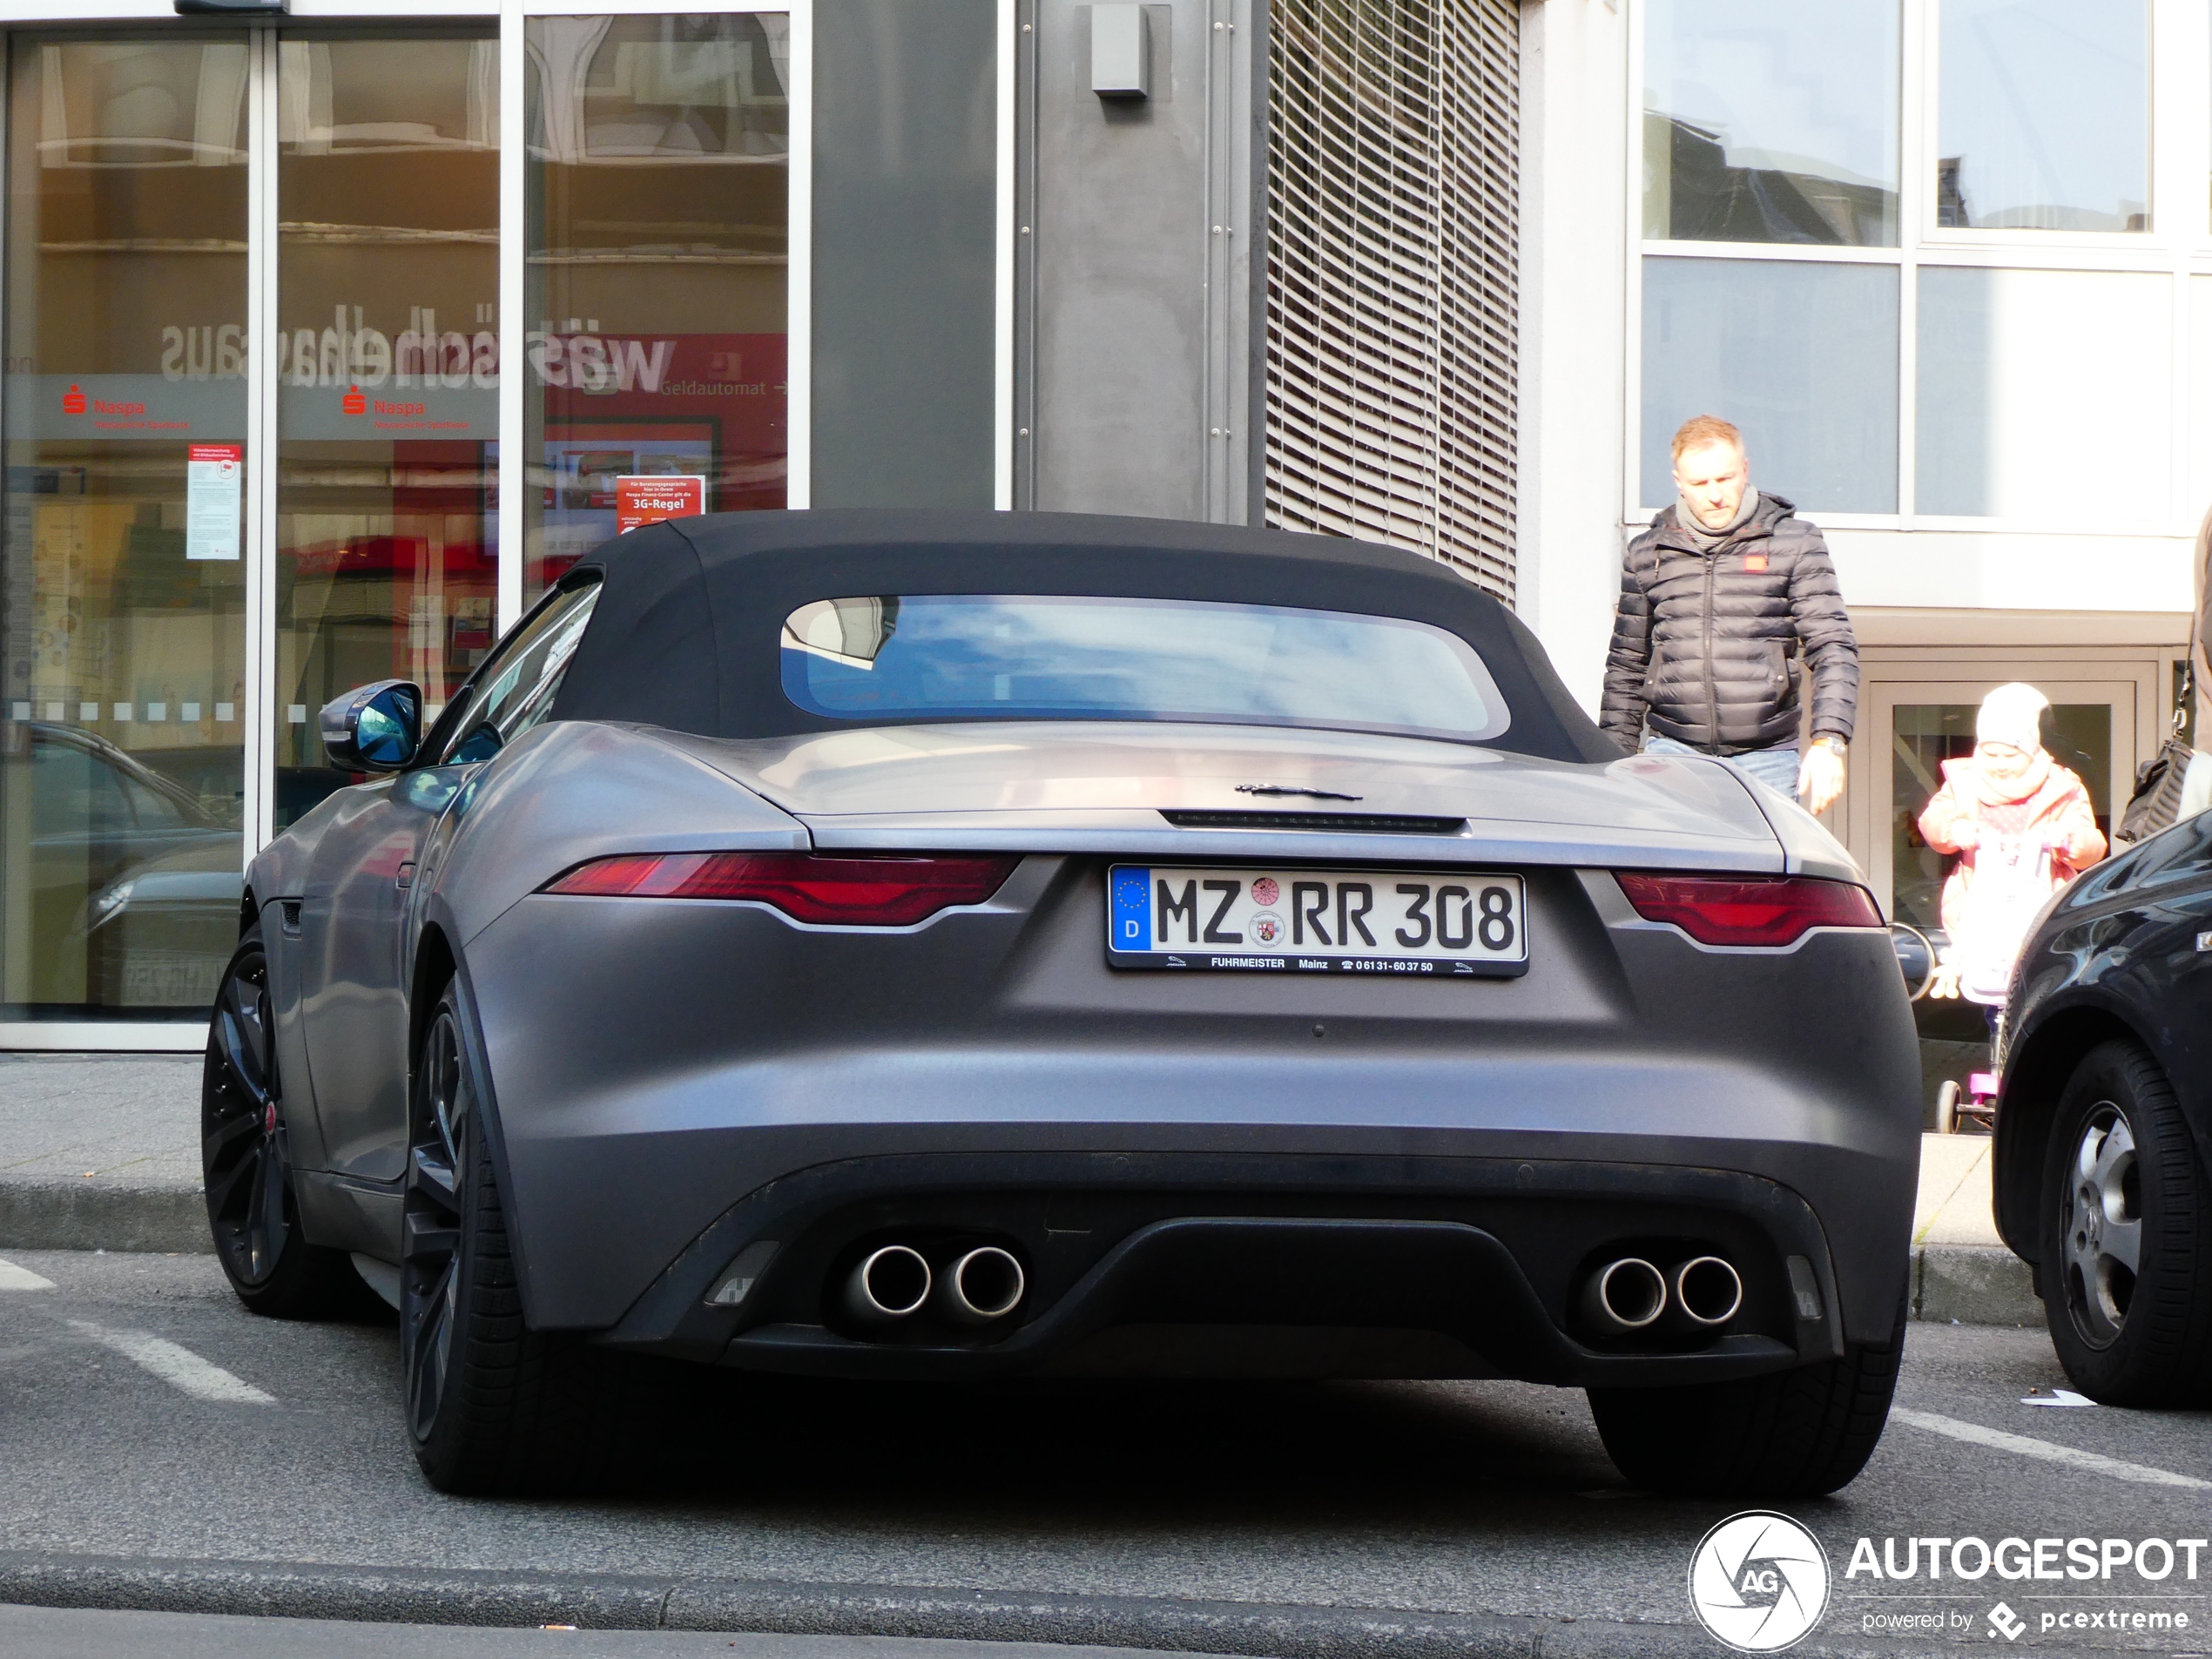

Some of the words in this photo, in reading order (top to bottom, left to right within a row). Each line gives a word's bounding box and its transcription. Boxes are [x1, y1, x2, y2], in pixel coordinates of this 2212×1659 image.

[660, 381, 766, 395] Geldautomat
[94, 400, 145, 416] Naspa
[374, 401, 425, 416] Naspa
[633, 498, 685, 510] 3G-Regel
[1126, 921, 1139, 938] D
[1157, 879, 1243, 943] MZ
[1292, 882, 1377, 946] RR
[1396, 885, 1514, 950] 308
[1211, 957, 1285, 968] FUHRMEISTER
[1298, 960, 1328, 969] Mainz
